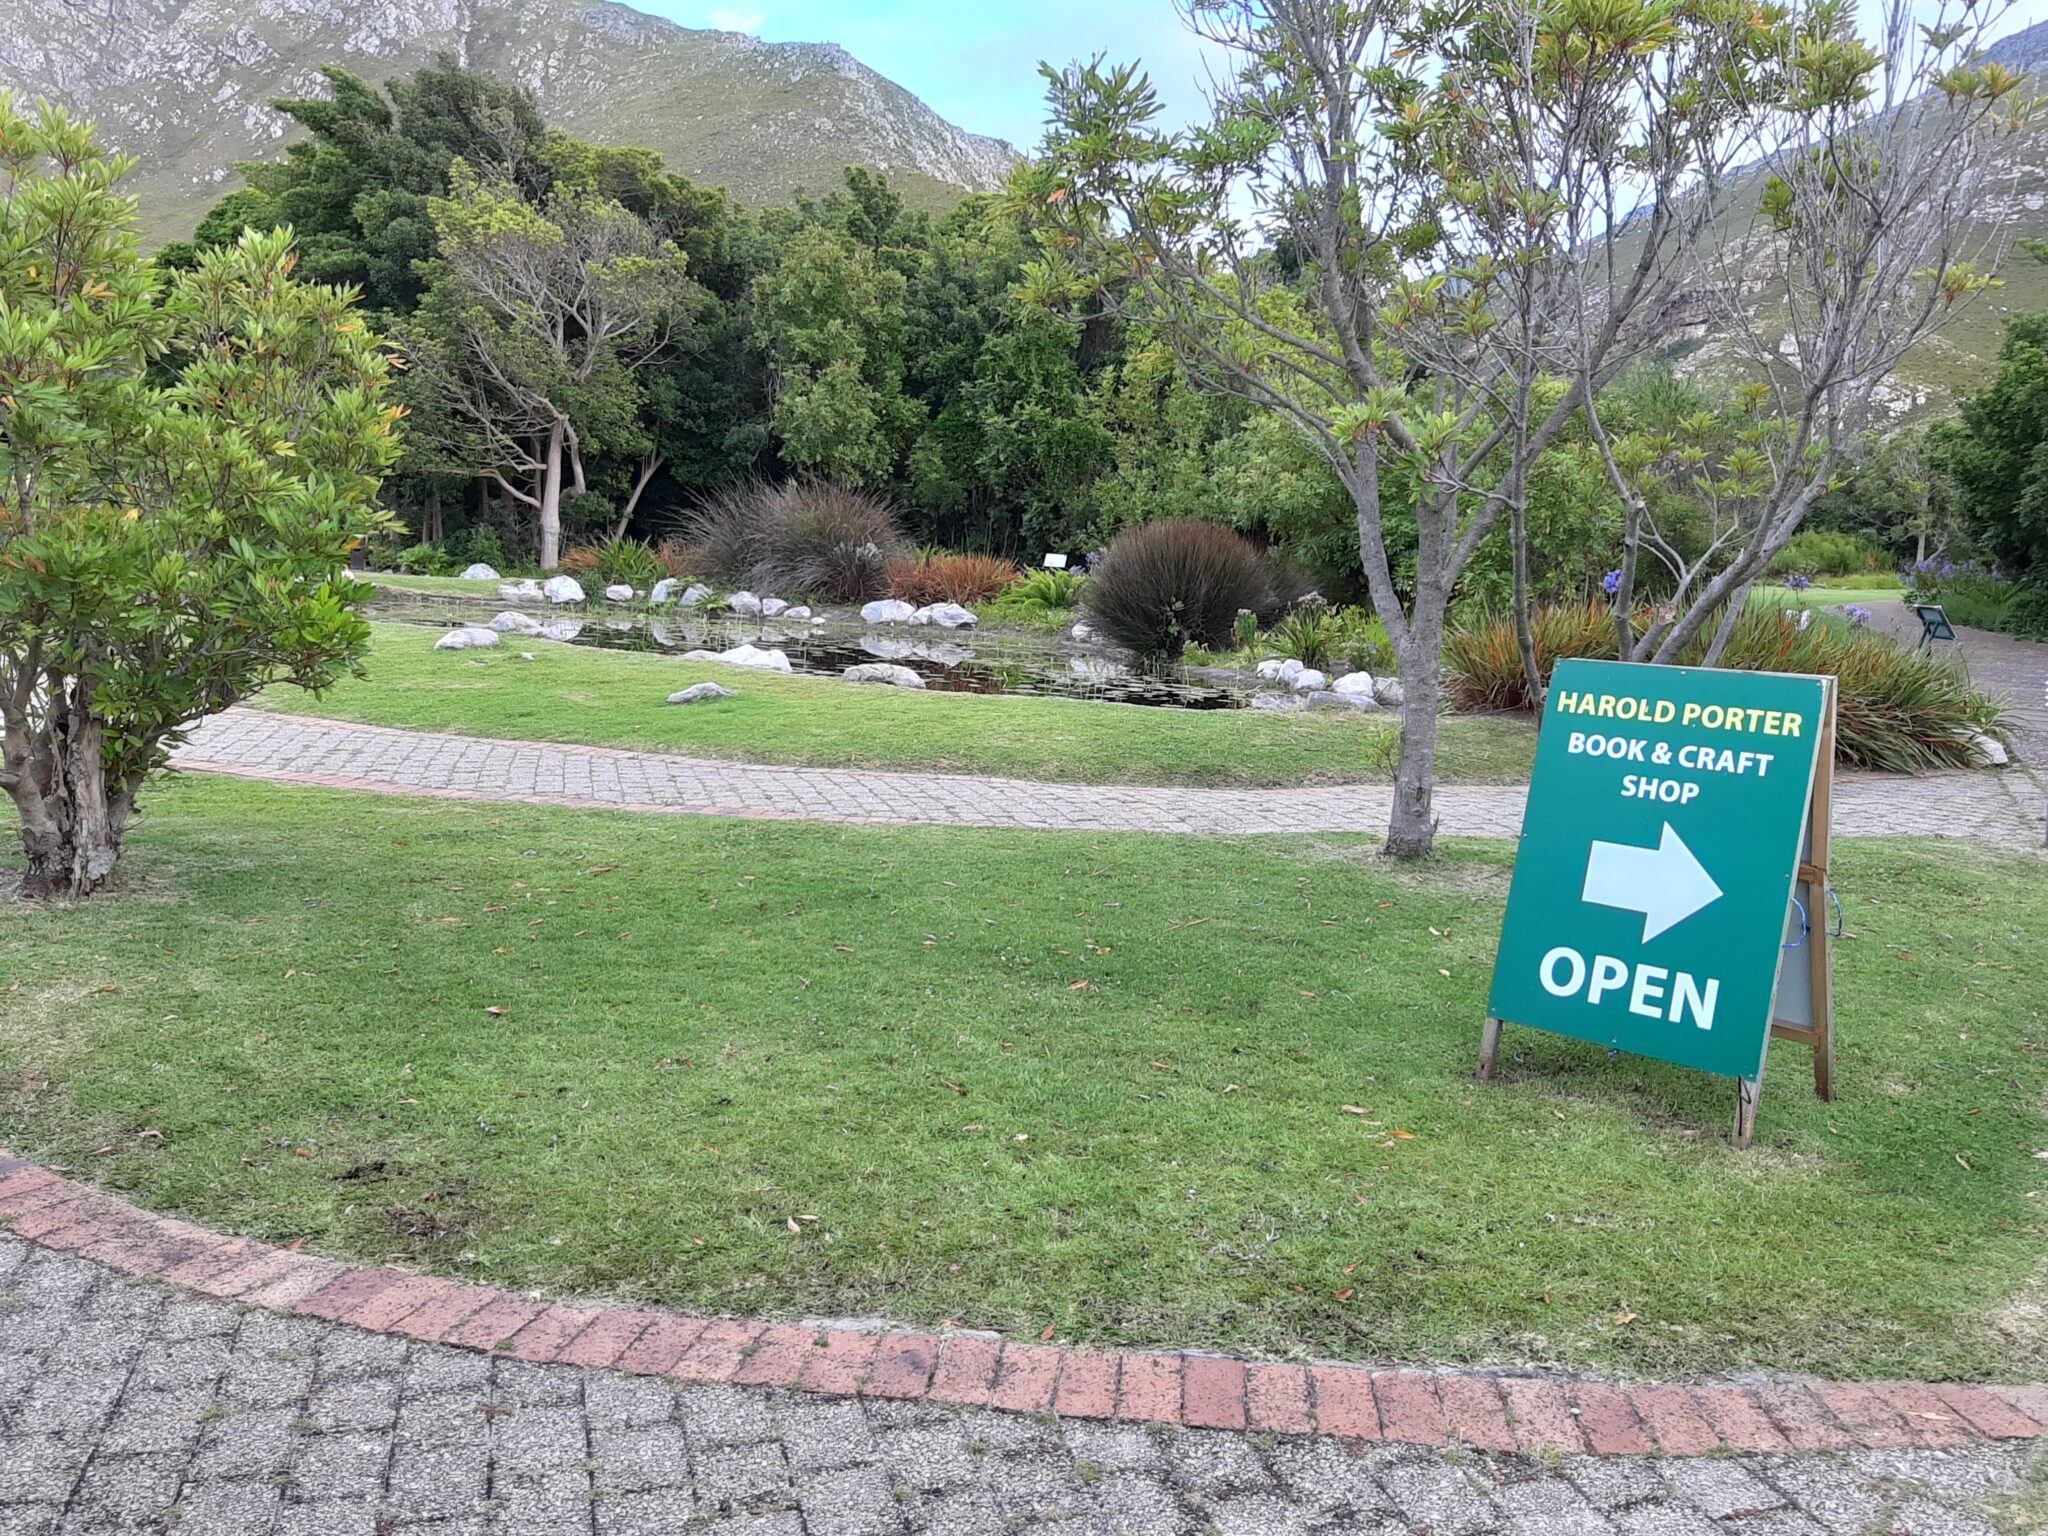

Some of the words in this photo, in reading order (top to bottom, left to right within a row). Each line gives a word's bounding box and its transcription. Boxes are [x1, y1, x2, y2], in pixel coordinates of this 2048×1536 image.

[1557, 690, 1676, 723] HAROLD
[1682, 703, 1802, 737] PORTER
[1567, 732, 1648, 762] BOOK
[1651, 742, 1673, 765] &
[1678, 745, 1774, 777] CRAFT
[1620, 775, 1700, 804] SHOP
[1539, 947, 1720, 1030] OPEN
